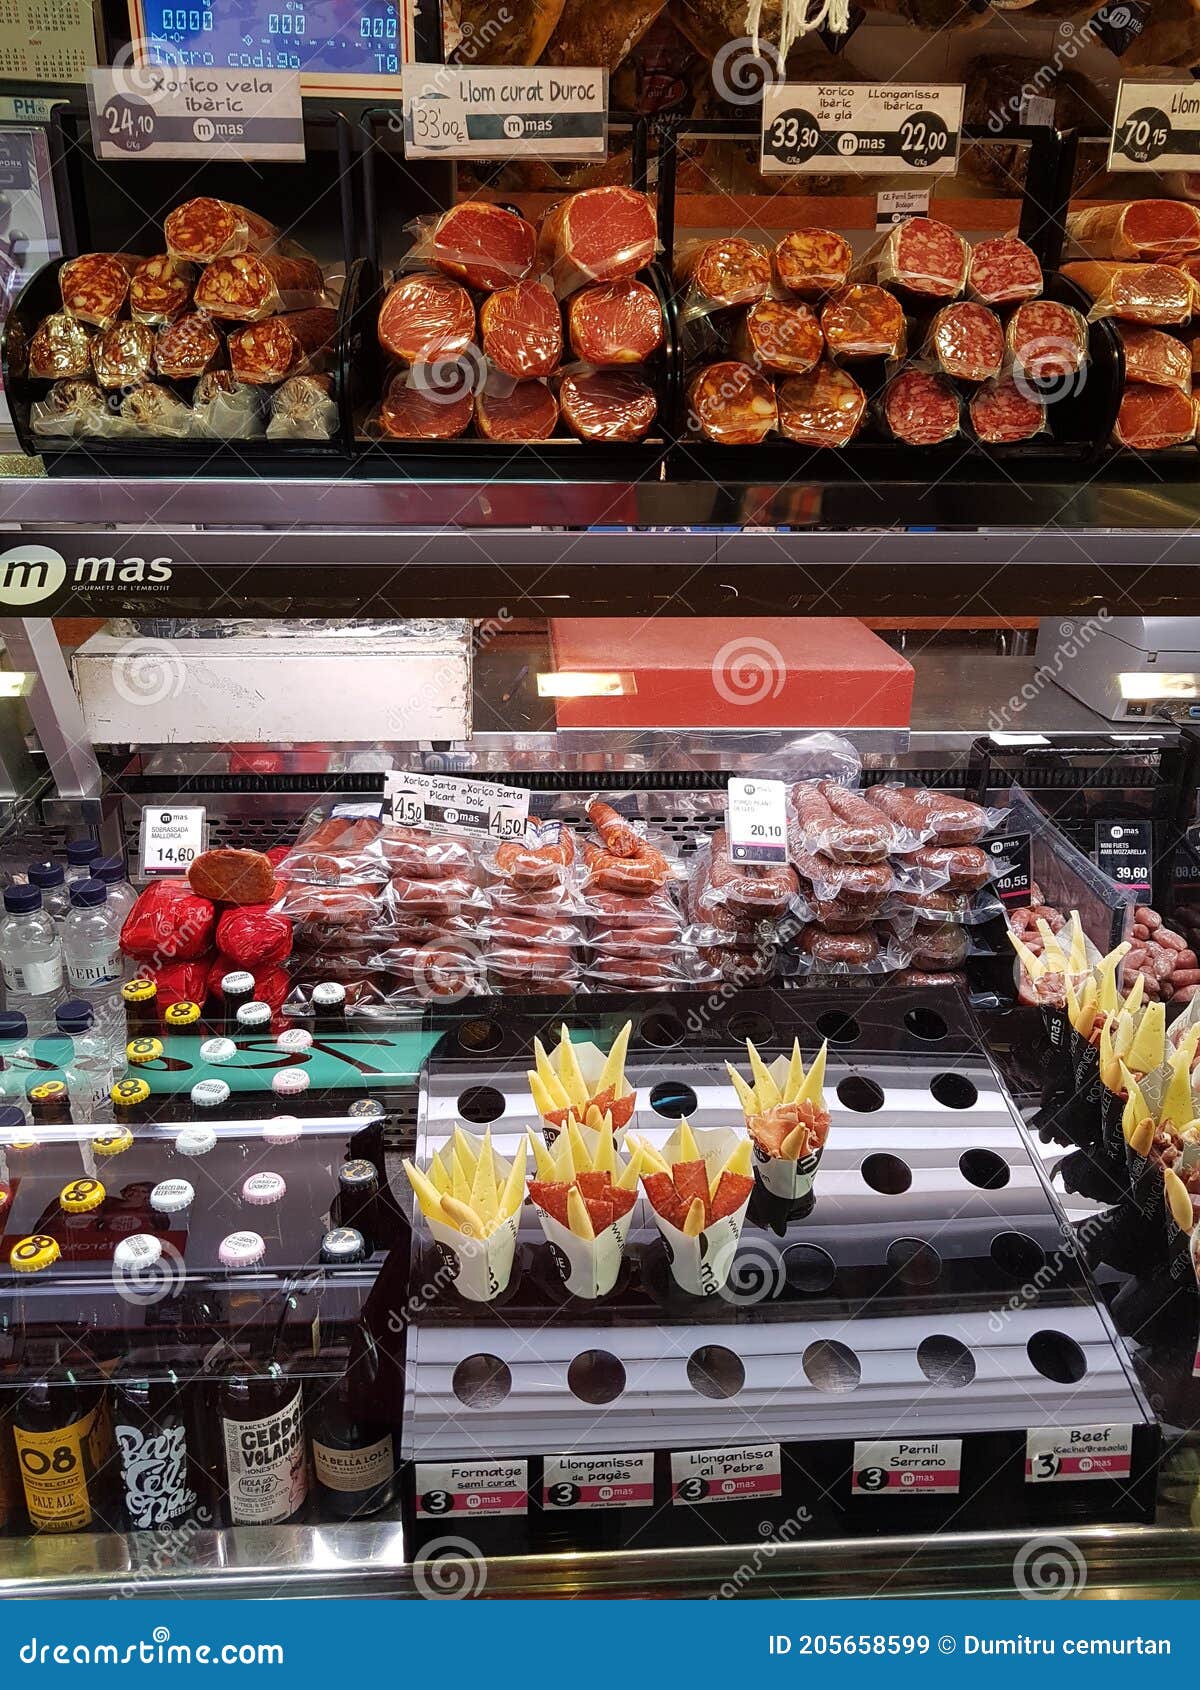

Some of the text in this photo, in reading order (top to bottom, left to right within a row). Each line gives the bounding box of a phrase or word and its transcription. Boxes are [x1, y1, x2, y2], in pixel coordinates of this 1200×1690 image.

[162, 9, 214, 31] 0.000
[268, 14, 305, 34] 0.00
[360, 18, 397, 38] 0.00
[153, 45, 301, 69] Intro codigo
[226, 77, 273, 94] vela
[459, 80, 596, 103] Llom curat Duroc
[817, 86, 855, 97] Xorico
[185, 97, 244, 112] ibèric
[819, 97, 852, 109] ibèric
[883, 101, 923, 111] ibèrica
[1171, 89, 1200, 114] Llom
[105, 106, 154, 137] 24,10
[817, 110, 831, 120] de
[215, 122, 245, 136] mas
[526, 119, 553, 132] mas
[771, 117, 819, 153] 33,30
[859, 134, 886, 150] mas
[900, 122, 948, 155] 22,00
[1124, 120, 1168, 151] 70,15
[73, 556, 173, 583] mas
[117, 584, 127, 592] DE
[431, 779, 457, 792] Sarta
[496, 788, 523, 801] Sarta
[459, 812, 480, 823] mas
[750, 824, 782, 838] 20,10
[1123, 826, 1140, 836] mas
[1003, 839, 1020, 849] mas
[157, 847, 195, 864] 14,60
[1116, 866, 1148, 880] 39,60
[996, 874, 1028, 890] 40,55
[240, 1407, 299, 1451] CERDO
[1070, 1428, 1112, 1444] Beef
[899, 1444, 939, 1455] Pernil
[20, 1445, 77, 1476] 08
[329, 1456, 362, 1467] BELLA
[559, 1457, 644, 1472] Llonganissa
[690, 1449, 774, 1467] Llonganissa
[889, 1456, 946, 1467] Serrano
[1093, 1457, 1113, 1468] mas
[451, 1466, 522, 1479] Formatge
[572, 1470, 631, 1483] de pagès
[700, 1461, 764, 1477] al Pebre
[457, 1479, 517, 1489] semi curat
[736, 1479, 756, 1490] mas
[864, 1468, 882, 1487] 3
[915, 1473, 935, 1482] mas
[556, 1483, 573, 1503] 3
[613, 1487, 633, 1497] mas
[685, 1479, 702, 1498] 3
[32, 1492, 76, 1509] PALE ALE
[429, 1491, 447, 1511] 3
[481, 1495, 502, 1504] mas
